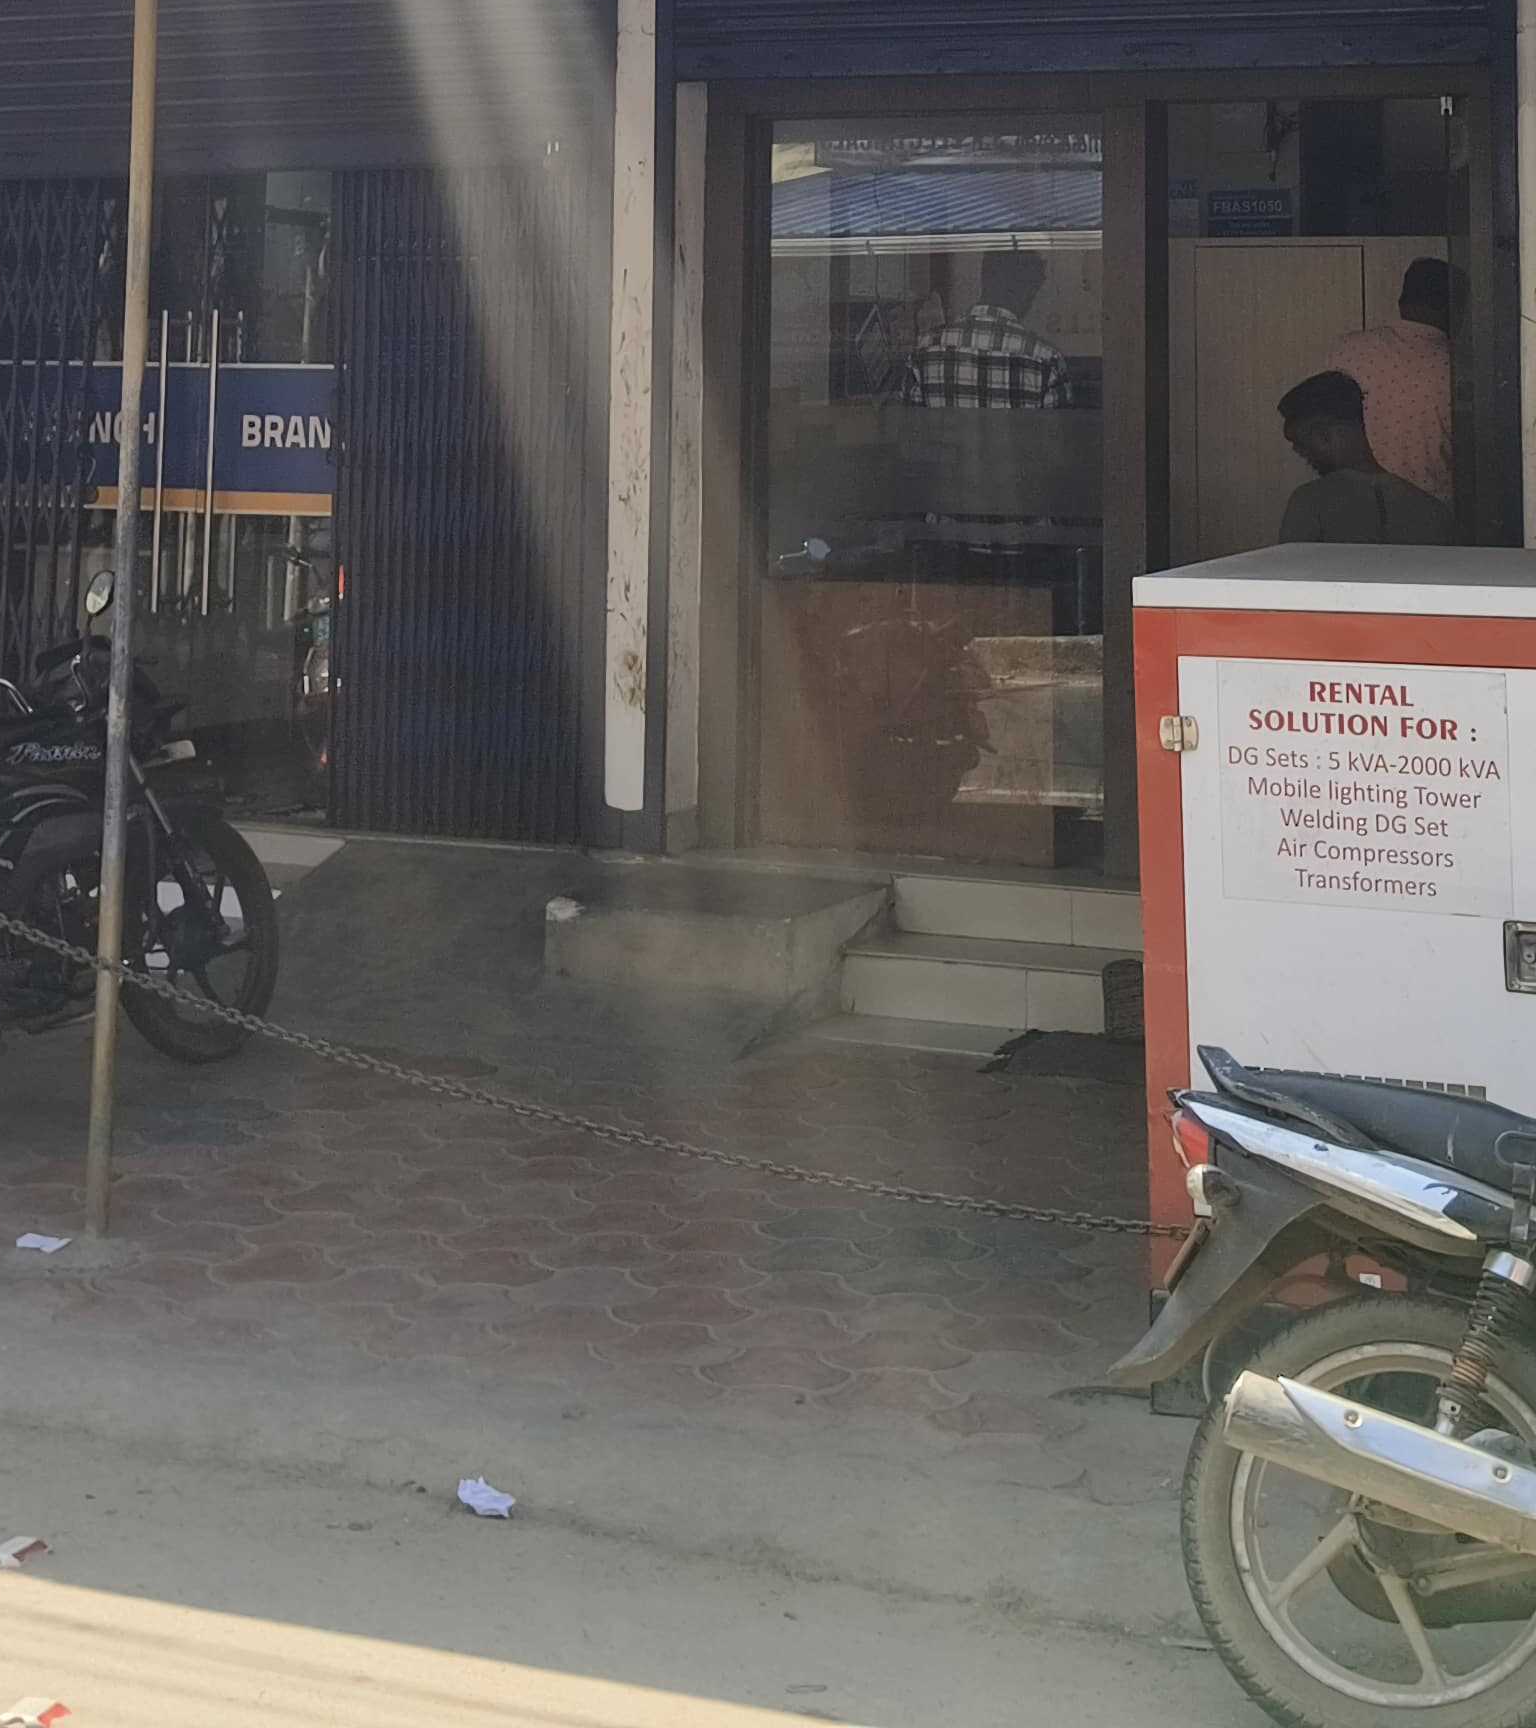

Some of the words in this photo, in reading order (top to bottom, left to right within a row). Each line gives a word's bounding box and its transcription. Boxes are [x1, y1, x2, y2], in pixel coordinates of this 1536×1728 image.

[241, 414, 332, 449] BRAN
[1309, 680, 1415, 708] RENTAL
[1248, 708, 1390, 738] SOLUTION
[1400, 717, 1459, 742] FOR
[1227, 745, 1259, 767] DG
[1265, 747, 1309, 770] Sets
[1328, 751, 1341, 771] 5
[1348, 751, 1452, 778] kVA-2000
[1459, 757, 1502, 781] kVA
[1248, 776, 1322, 800] Mobile
[1328, 779, 1409, 809] lighting
[1414, 785, 1483, 810] Tower
[1280, 808, 1369, 837] Welding
[1375, 813, 1408, 835] DG
[1414, 816, 1450, 838] Set
[1277, 837, 1307, 858] Air
[1314, 840, 1455, 869] Compressors
[1295, 868, 1438, 897] Transformers
